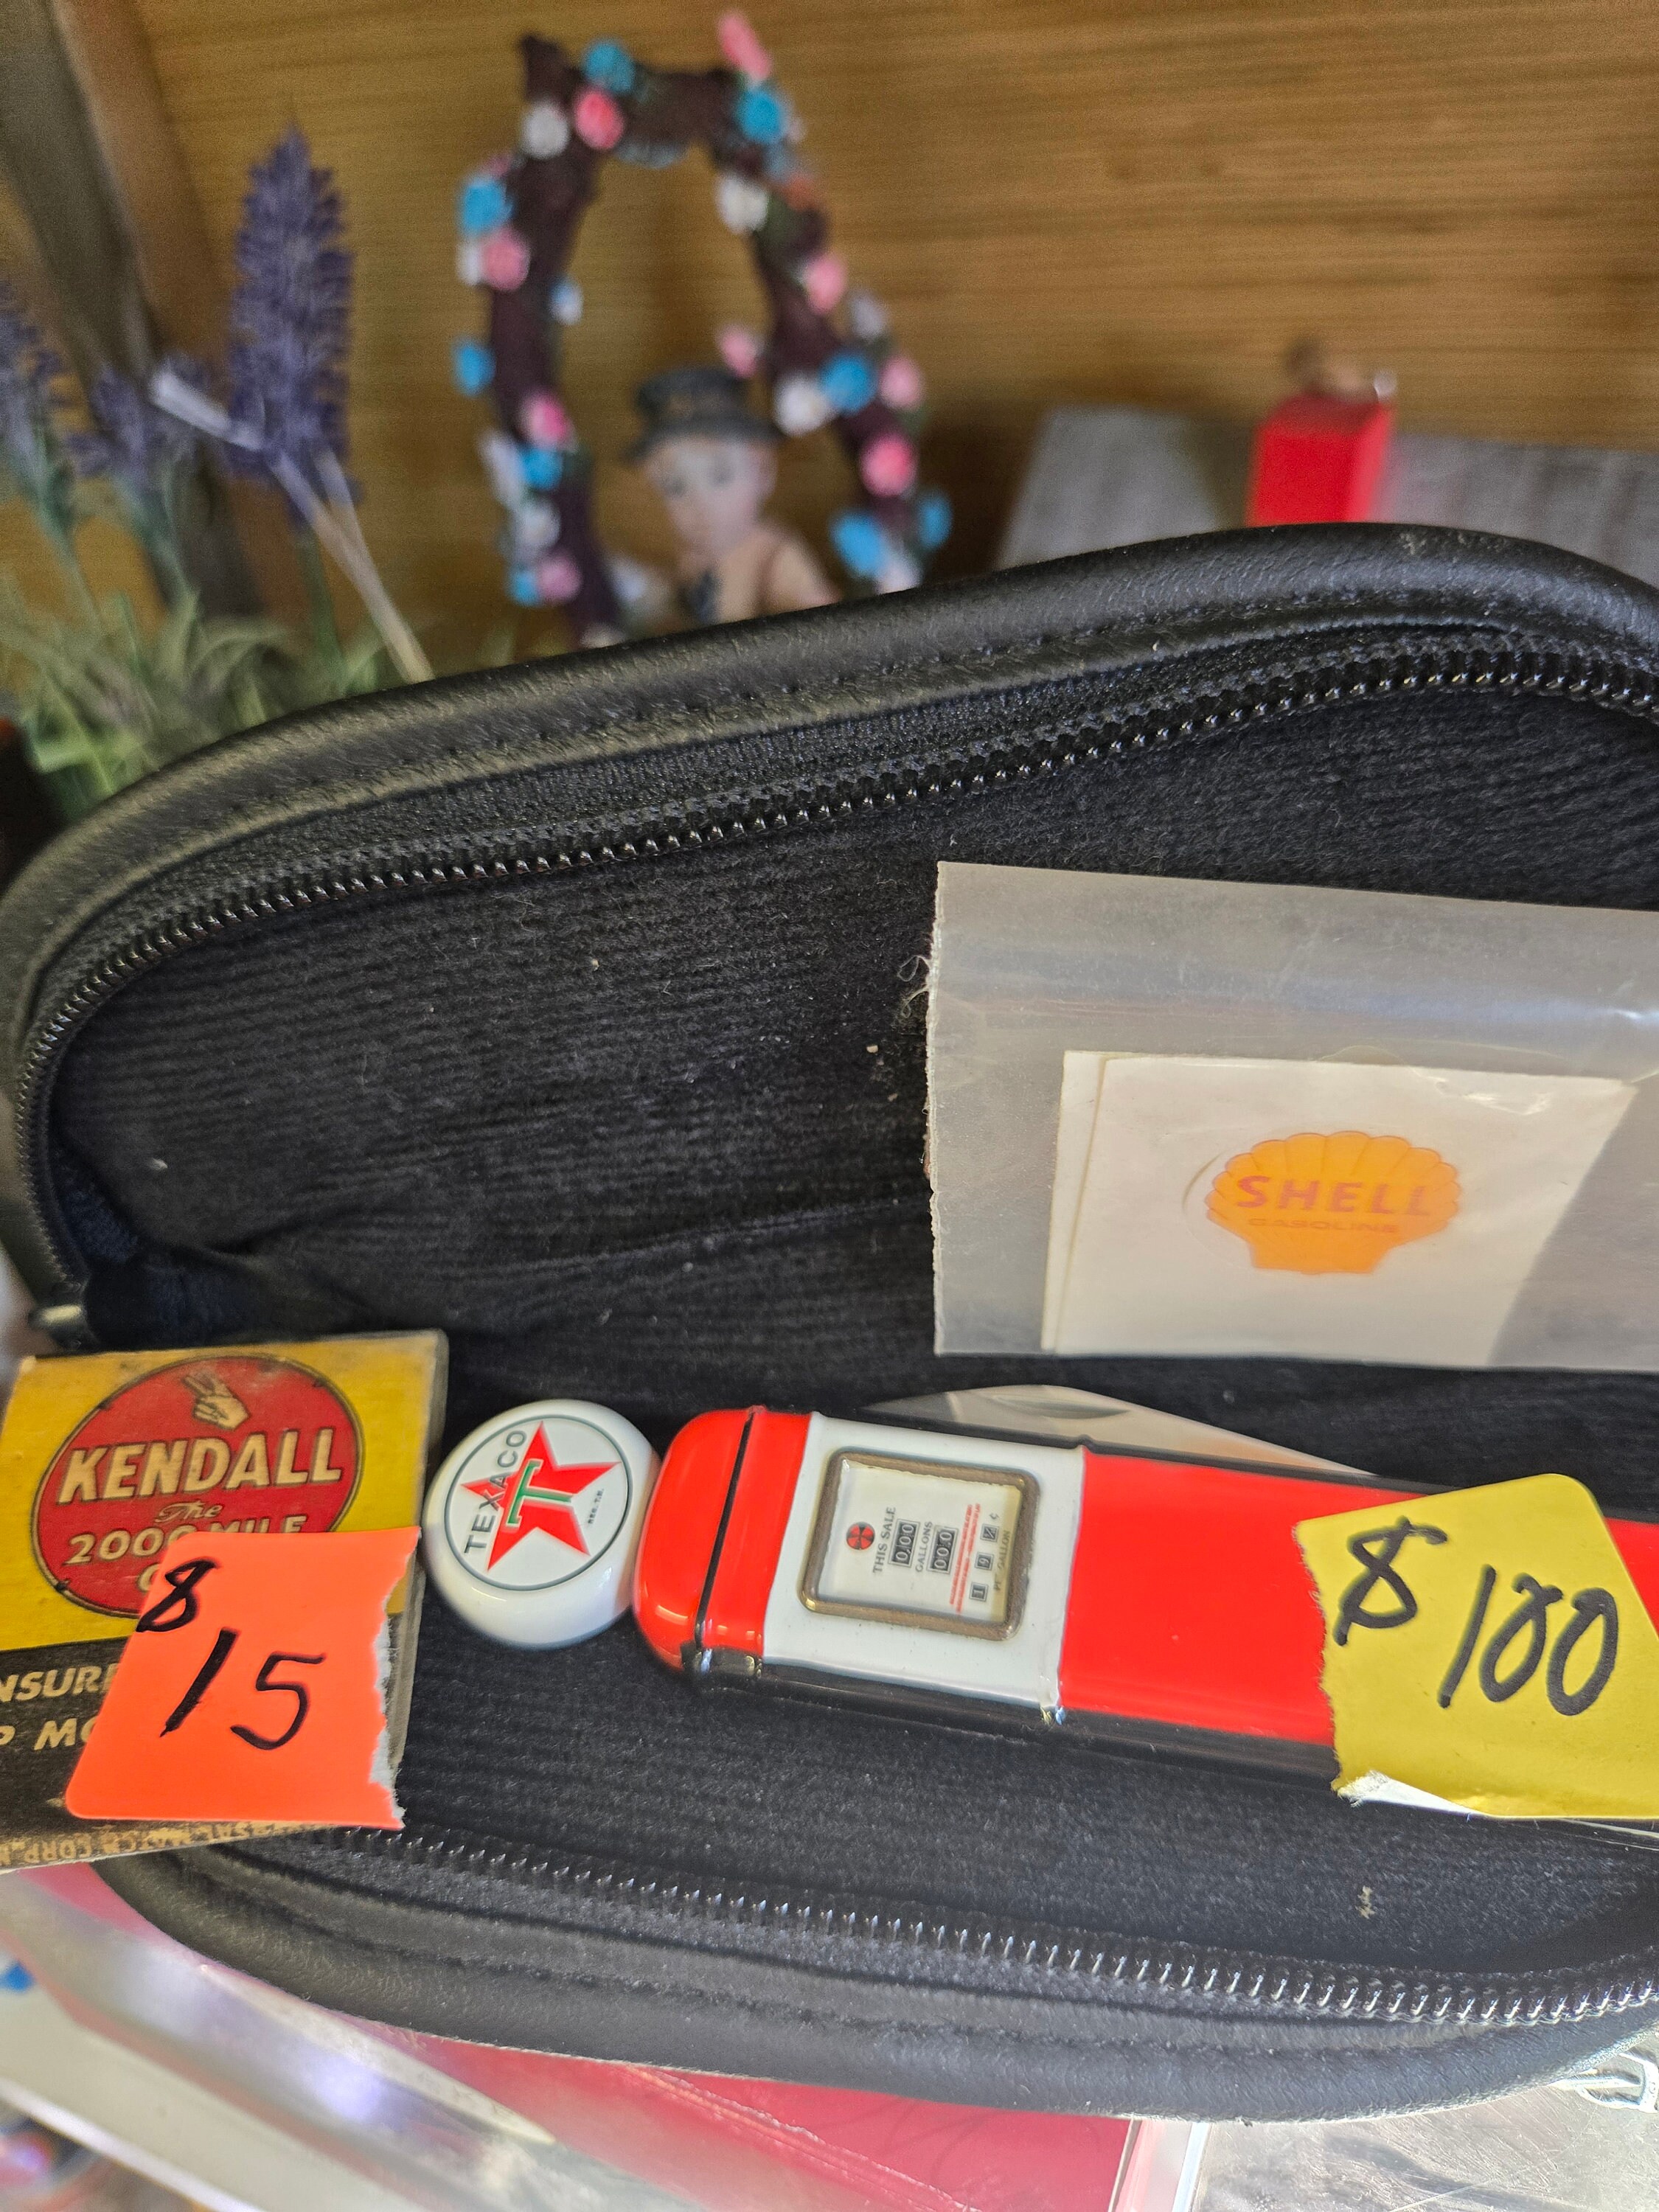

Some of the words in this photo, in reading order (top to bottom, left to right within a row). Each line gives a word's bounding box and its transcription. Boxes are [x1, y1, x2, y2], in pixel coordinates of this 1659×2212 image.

[1237, 1175, 1430, 1217] SHELL
[1248, 1217, 1399, 1234] GASOLINE
[58, 1427, 342, 1506] KENDALL
[154, 1500, 223, 1524] The
[465, 1430, 526, 1554] TEXACO
[506, 1458, 573, 1527] T
[880, 1506, 897, 1539] SALE
[873, 1543, 888, 1573] THIS
[915, 1520, 933, 1573] GALLONS
